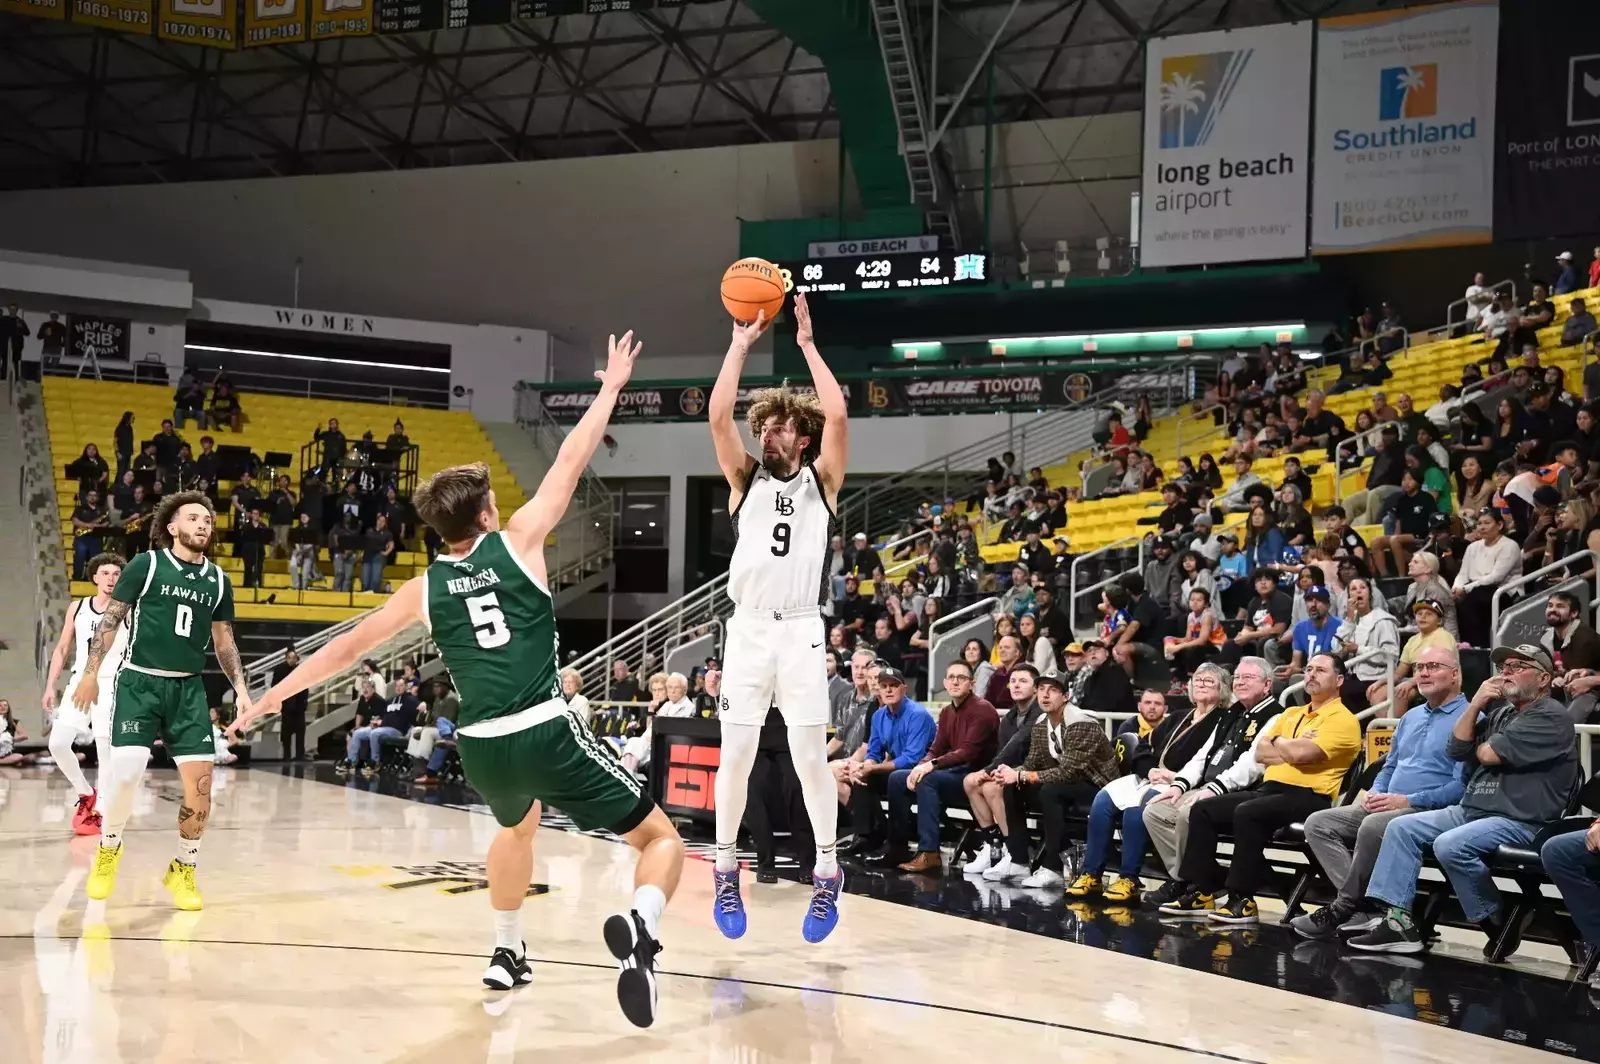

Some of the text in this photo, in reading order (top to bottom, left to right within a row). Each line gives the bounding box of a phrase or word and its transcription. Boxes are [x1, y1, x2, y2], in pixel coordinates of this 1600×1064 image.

[77, 0, 149, 24] 1969-1973
[1333, 116, 1476, 152] Southland
[1345, 145, 1463, 164] CREDIT UNION
[1507, 141, 1540, 155] Port
[1543, 137, 1560, 154] of
[1157, 152, 1293, 186] long beach
[1528, 158, 1552, 173] THE
[1555, 154, 1588, 169] PORT
[1155, 187, 1233, 215] airport
[1155, 229, 1190, 242] where
[1192, 228, 1211, 240] the
[1213, 226, 1245, 240] going
[1247, 225, 1256, 236] is
[838, 243, 858, 254] GO
[861, 240, 908, 254] BEACH
[803, 264, 823, 281] 66
[855, 260, 892, 277] 4:29
[920, 257, 940, 274] 54
[74, 320, 122, 337] NAPLES
[276, 310, 374, 333] WOMEN
[84, 331, 113, 346] RIB
[868, 380, 889, 409] LB
[907, 377, 1042, 396] CABE TOYOTA
[547, 391, 662, 407] CAB OYOTA
[989, 393, 1040, 404] Since 1966
[638, 406, 660, 415] 1966
[774, 490, 795, 517] LB
[771, 522, 792, 557] 9
[174, 604, 194, 638] 0
[465, 591, 511, 649] 5
